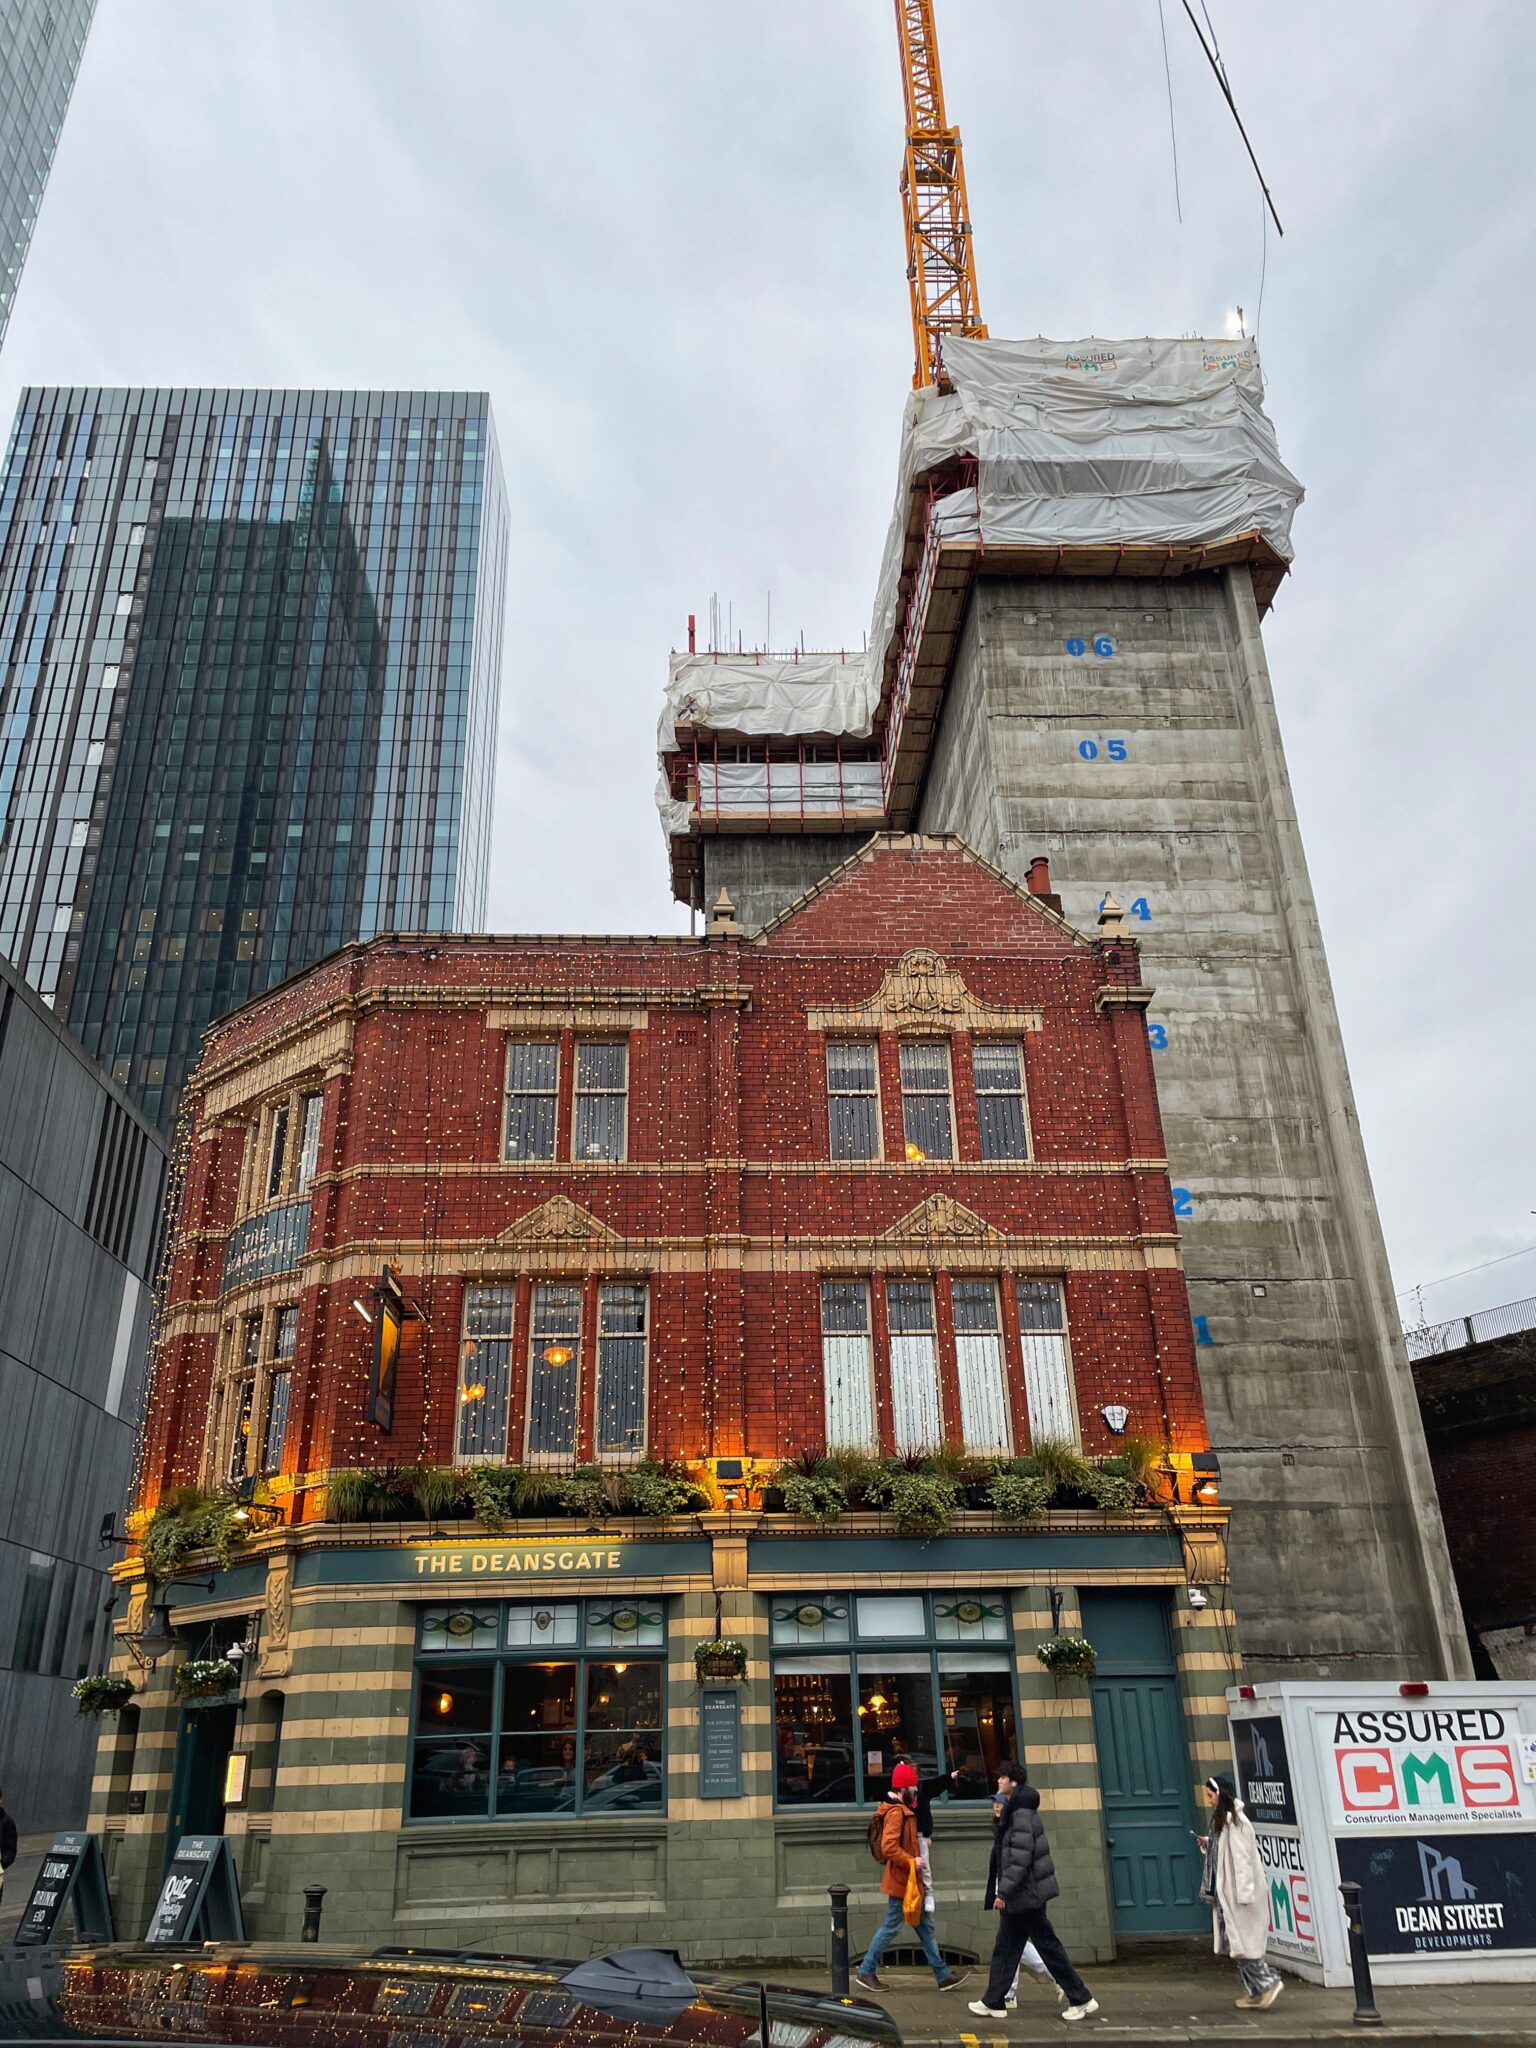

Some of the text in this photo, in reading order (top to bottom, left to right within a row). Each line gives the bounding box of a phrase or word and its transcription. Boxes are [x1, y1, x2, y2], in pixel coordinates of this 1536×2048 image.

[1066, 353, 1115, 361] ASSURED
[1172, 1188, 1193, 1216] 2
[1194, 1315, 1213, 1345] 1
[415, 1551, 621, 1574] THE DEANSGATE
[1333, 1709, 1505, 1743] ASSURED
[1335, 1745, 1519, 1811] CMS
[1248, 1781, 1286, 1805] DEAN STREET
[1345, 1809, 1522, 1825] Construction Management Specialists
[177, 1850, 212, 1859] DEANSGATE
[192, 1841, 204, 1849] THE
[43, 1862, 70, 1879] LUNCH
[33, 1890, 59, 1907] DRINK
[1395, 1903, 1504, 1933] DEAN STREET
[1415, 1934, 1493, 1948] DEVELOPMENTS
